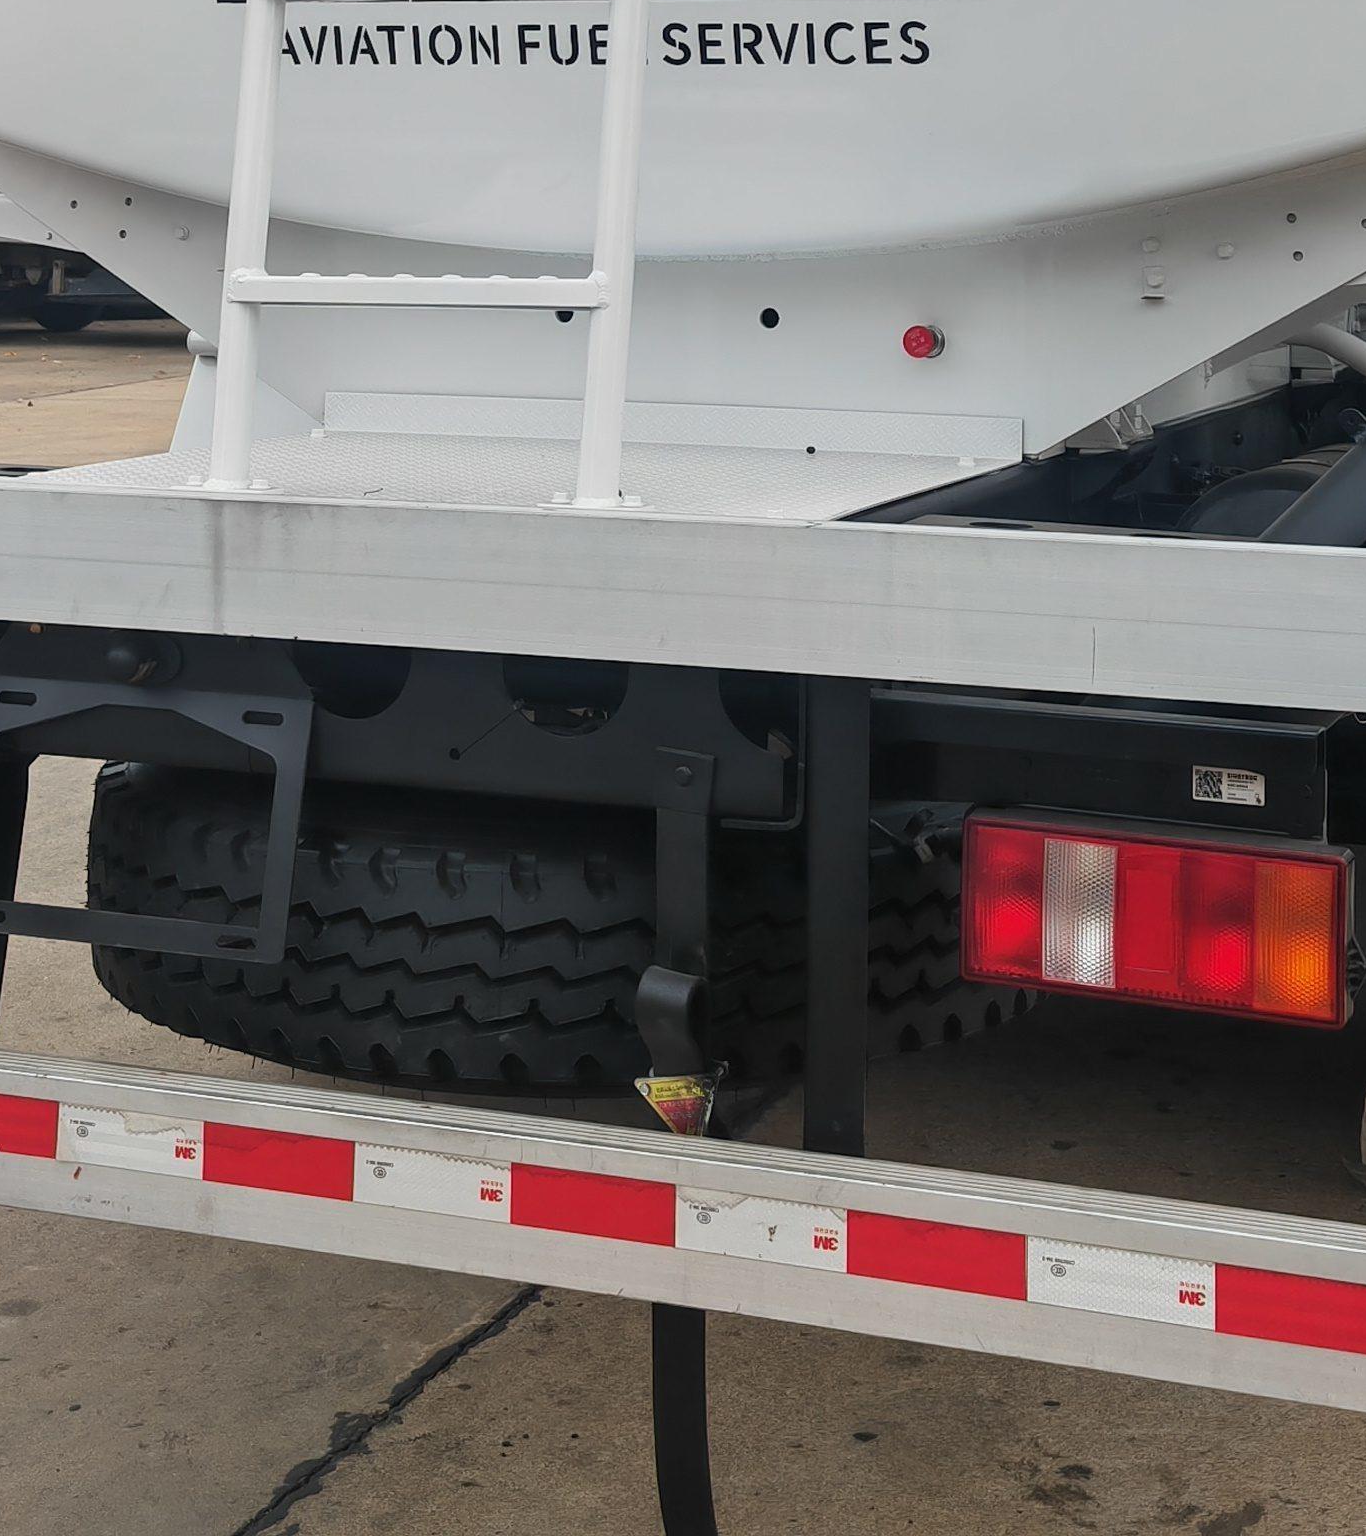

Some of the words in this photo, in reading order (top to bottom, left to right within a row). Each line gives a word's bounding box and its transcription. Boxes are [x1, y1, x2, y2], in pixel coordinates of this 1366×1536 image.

[517, 24, 645, 66] FUE
[662, 21, 930, 66] SERVICES
[174, 1145, 197, 1160] 3M
[480, 1187, 503, 1202] 3M
[813, 1235, 839, 1251] 3M
[1178, 1289, 1206, 1307] 3M
